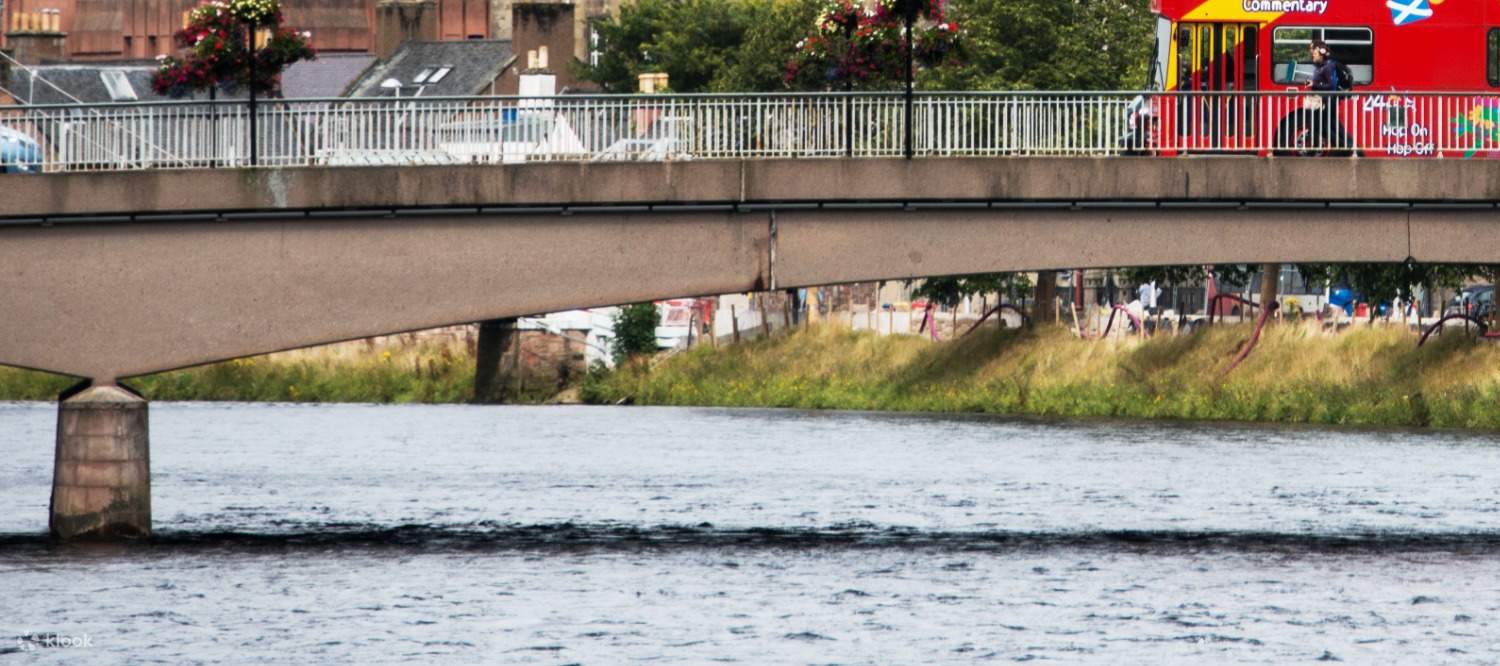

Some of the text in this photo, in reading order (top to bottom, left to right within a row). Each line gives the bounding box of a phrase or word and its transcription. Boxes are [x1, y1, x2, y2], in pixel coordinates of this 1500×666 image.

[1242, 0, 1328, 15] Commentary
[1383, 123, 1428, 138] Hop On
[1387, 142, 1434, 156] Hop Off
